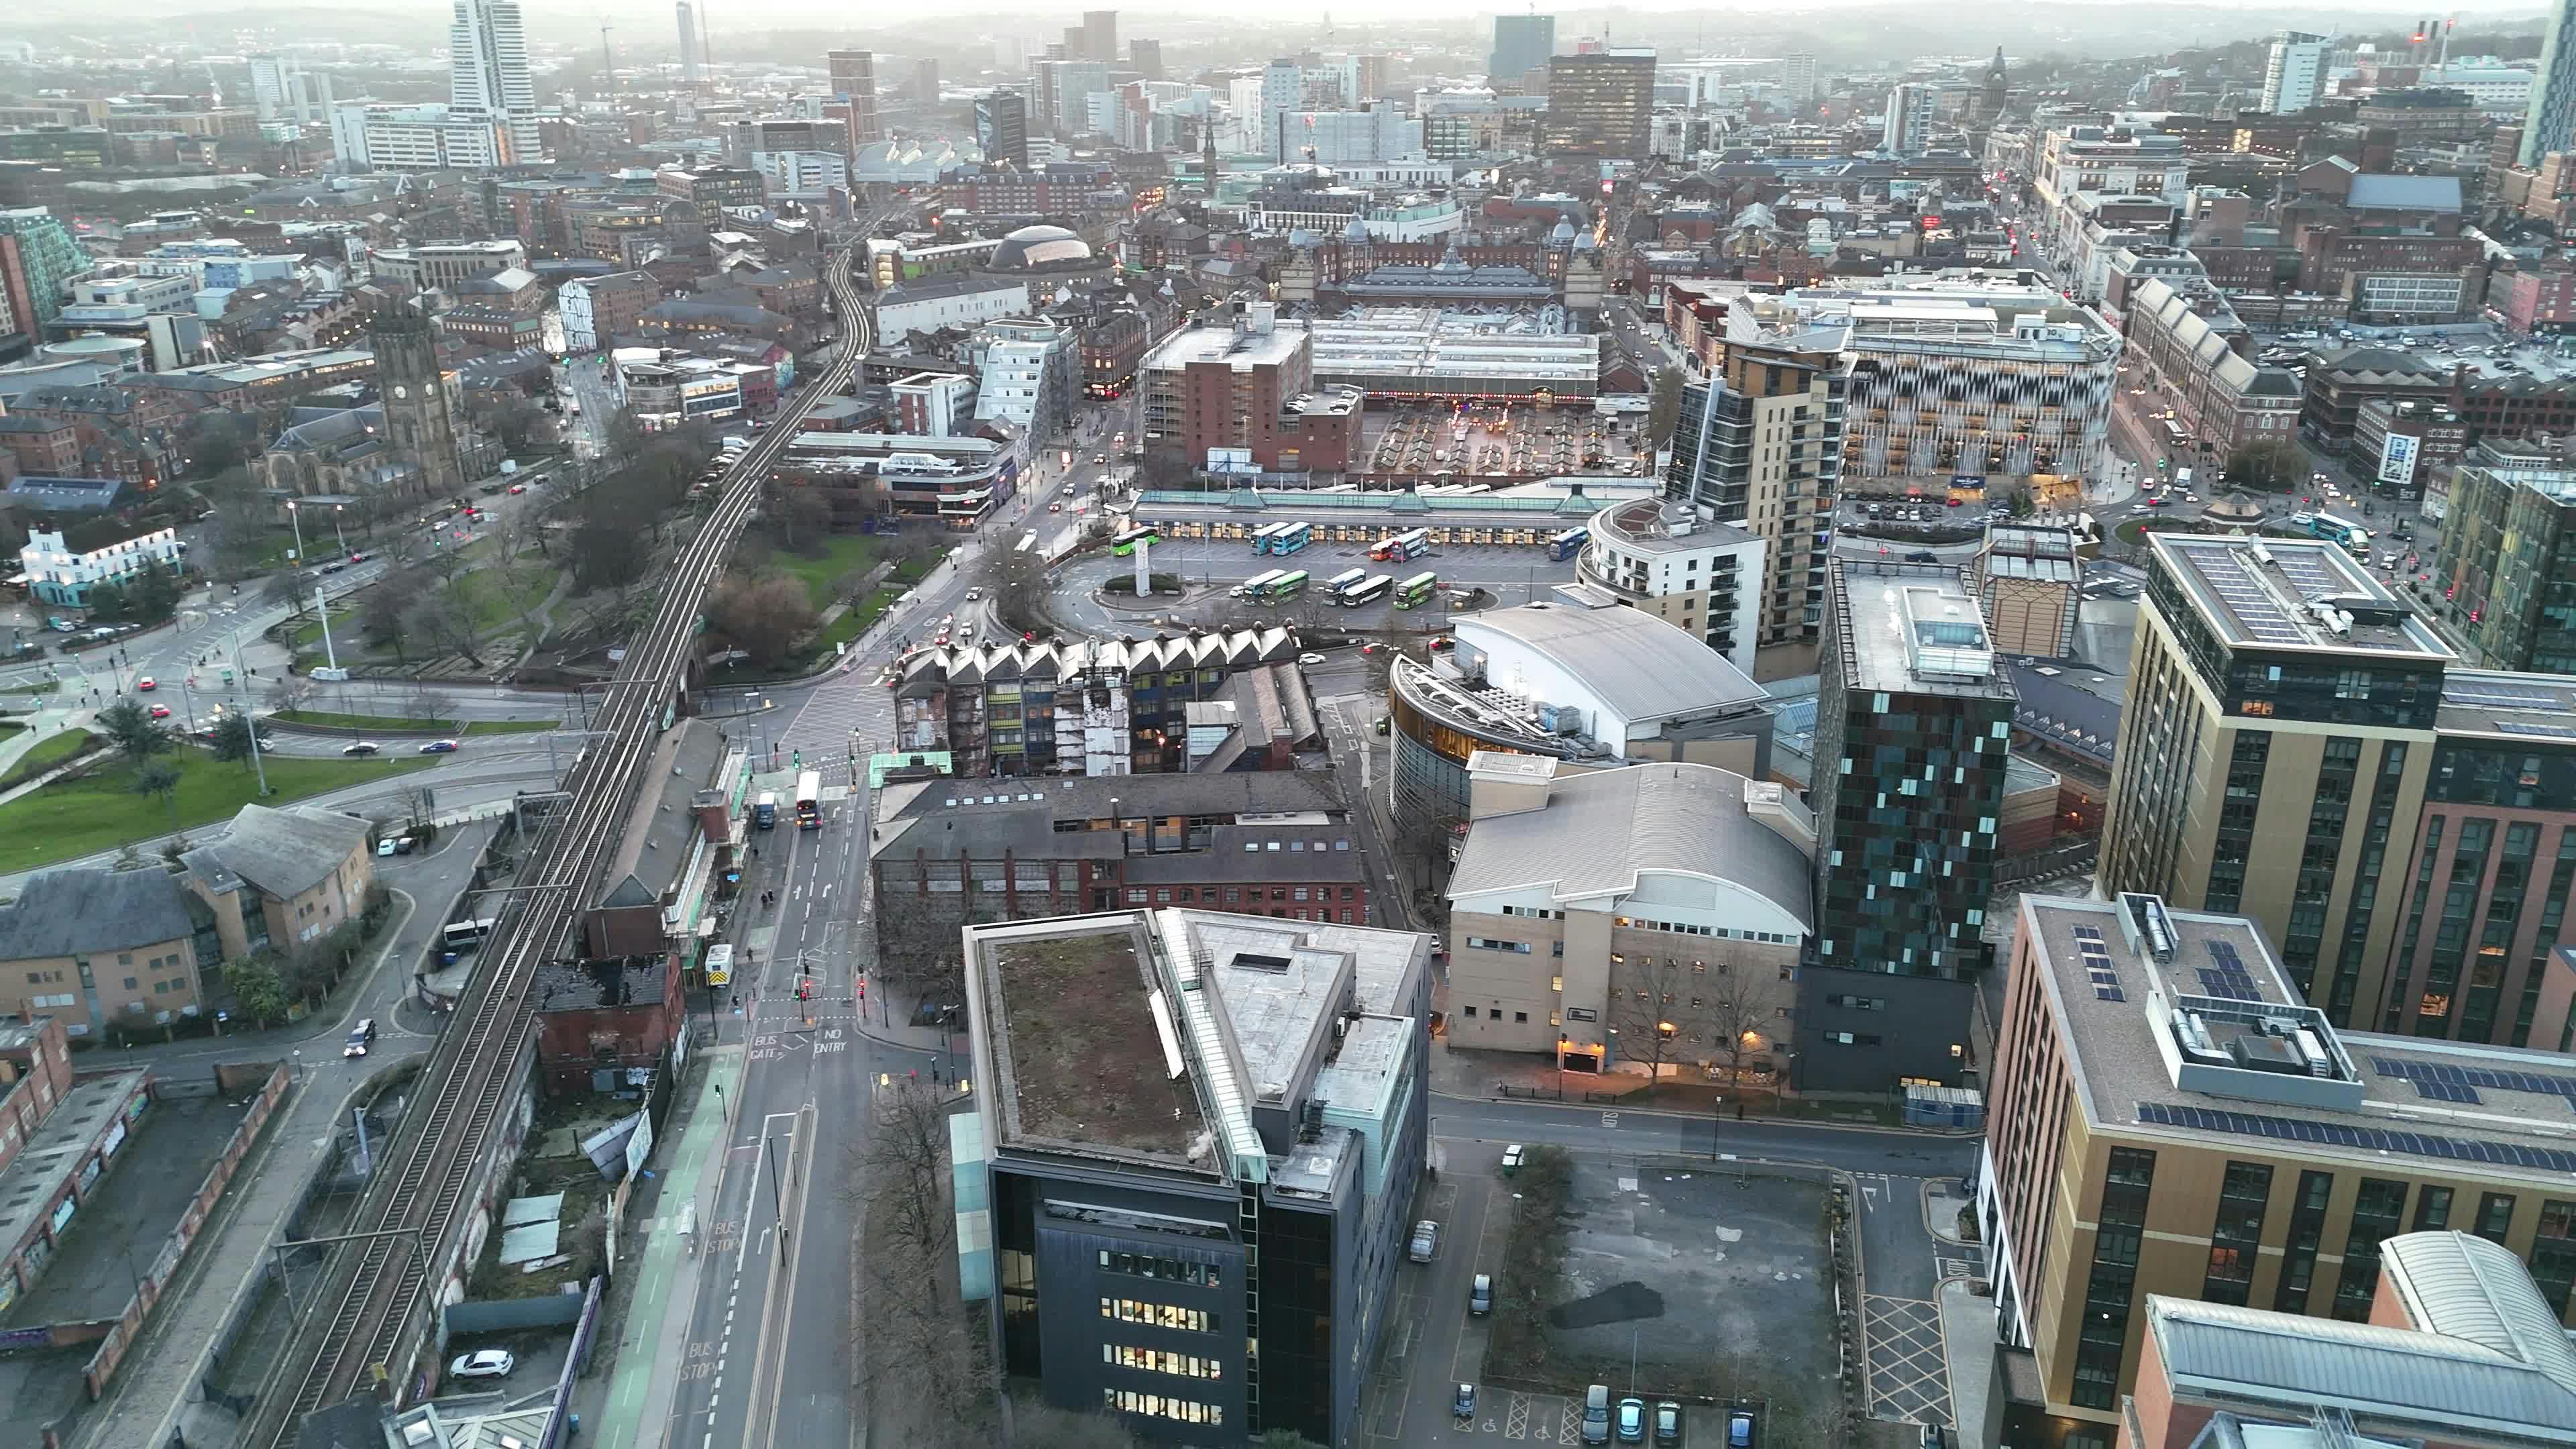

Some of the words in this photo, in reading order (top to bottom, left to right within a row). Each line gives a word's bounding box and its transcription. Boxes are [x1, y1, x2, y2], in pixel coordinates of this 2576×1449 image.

[755, 1035, 777, 1046] BUS
[824, 1029, 842, 1039] NO
[814, 1041, 847, 1054] ENTRY
[715, 1220, 737, 1235] BUS
[708, 1238, 739, 1253] STOP
[1947, 1260, 1972, 1277] STOP
[689, 1341, 714, 1358] BUS
[681, 1362, 716, 1381] STOP
